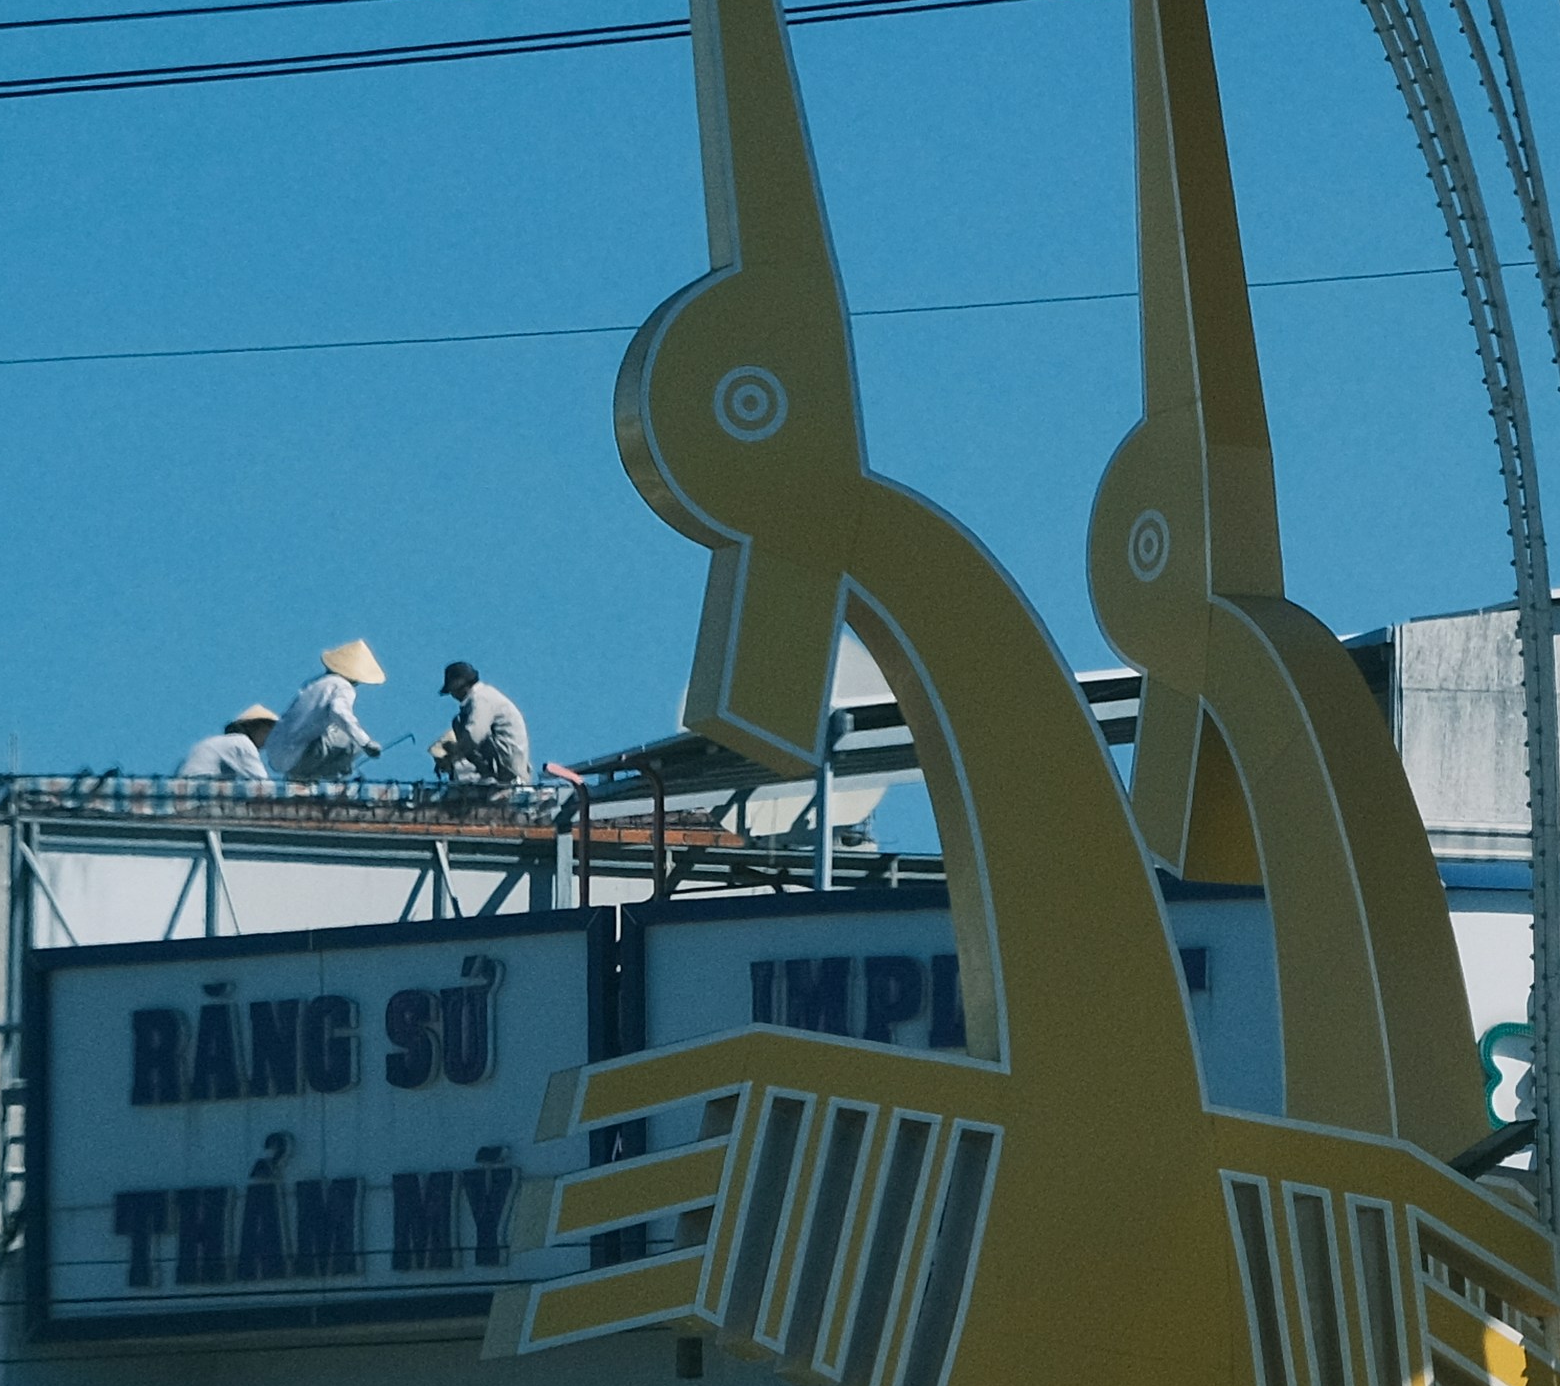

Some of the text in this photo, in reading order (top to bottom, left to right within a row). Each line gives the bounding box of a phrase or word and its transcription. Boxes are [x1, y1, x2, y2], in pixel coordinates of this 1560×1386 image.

[131, 954, 506, 1106] RĂNG SỨ
[114, 1130, 521, 1288] THẨM MỸ
